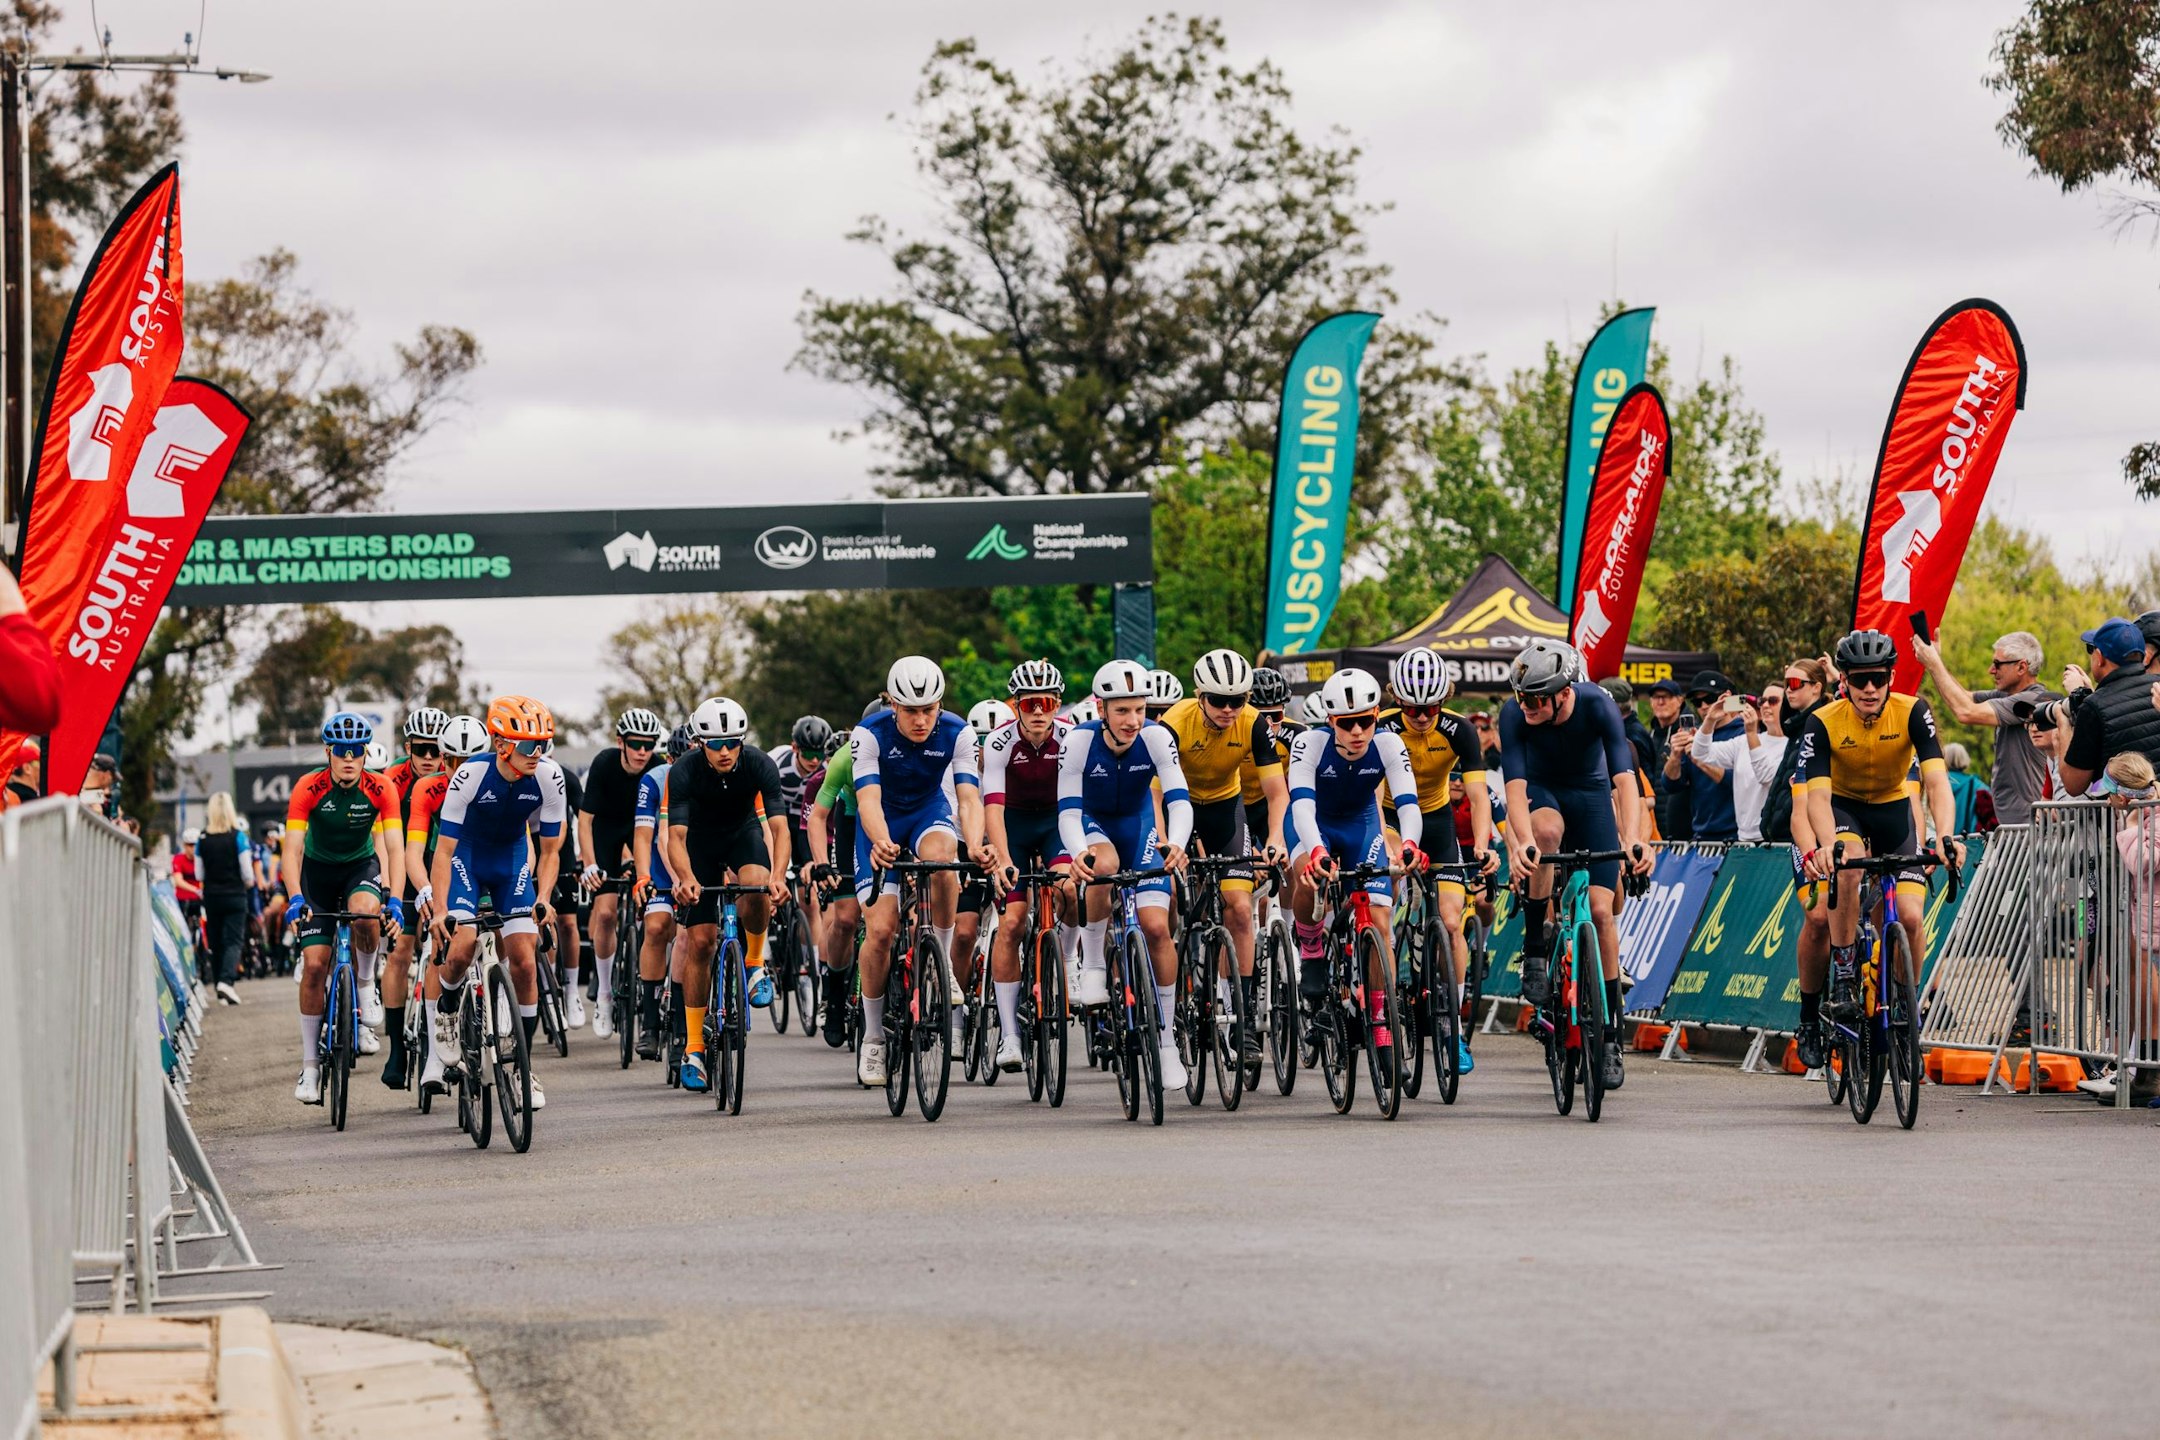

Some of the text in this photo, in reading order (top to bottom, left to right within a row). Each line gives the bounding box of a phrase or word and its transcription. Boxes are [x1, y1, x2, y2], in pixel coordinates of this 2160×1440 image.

[1933, 354, 1997, 494] SOUTH
[1599, 429, 1657, 595] ADELAIDE
[1033, 523, 1085, 537] National
[1033, 534, 1128, 549] Championships
[218, 538, 241, 560] &
[244, 535, 387, 560] MASTERS
[391, 533, 475, 556] ROAD
[658, 545, 721, 562] SOUTH
[823, 546, 872, 561] Loxton
[257, 556, 512, 583] CHAMPIONSHIPS
[659, 562, 721, 571] AUSTRALIA
[1607, 542, 1630, 602] SOUTH
[68, 523, 155, 666] SOUTH
[99, 538, 174, 672] AUSTRALIA
[1440, 717, 1458, 736] WA
[1922, 708, 1936, 738] WA
[991, 729, 1012, 752] QLD
[1291, 740, 1307, 764] VIC
[1400, 748, 1412, 772] VIC
[307, 779, 329, 797] TAS
[364, 778, 384, 797] TAS
[393, 770, 411, 788] TAS
[450, 769, 470, 792] VIC
[552, 771, 566, 795] VIC
[426, 782, 447, 800] TAS
[637, 783, 650, 808] NSW
[1366, 833, 1384, 865] ICTORIA
[1137, 876, 1165, 887] Santini
[1227, 869, 1253, 878] Santini
[1435, 873, 1462, 881] Santini
[1899, 870, 1926, 883] Santini
